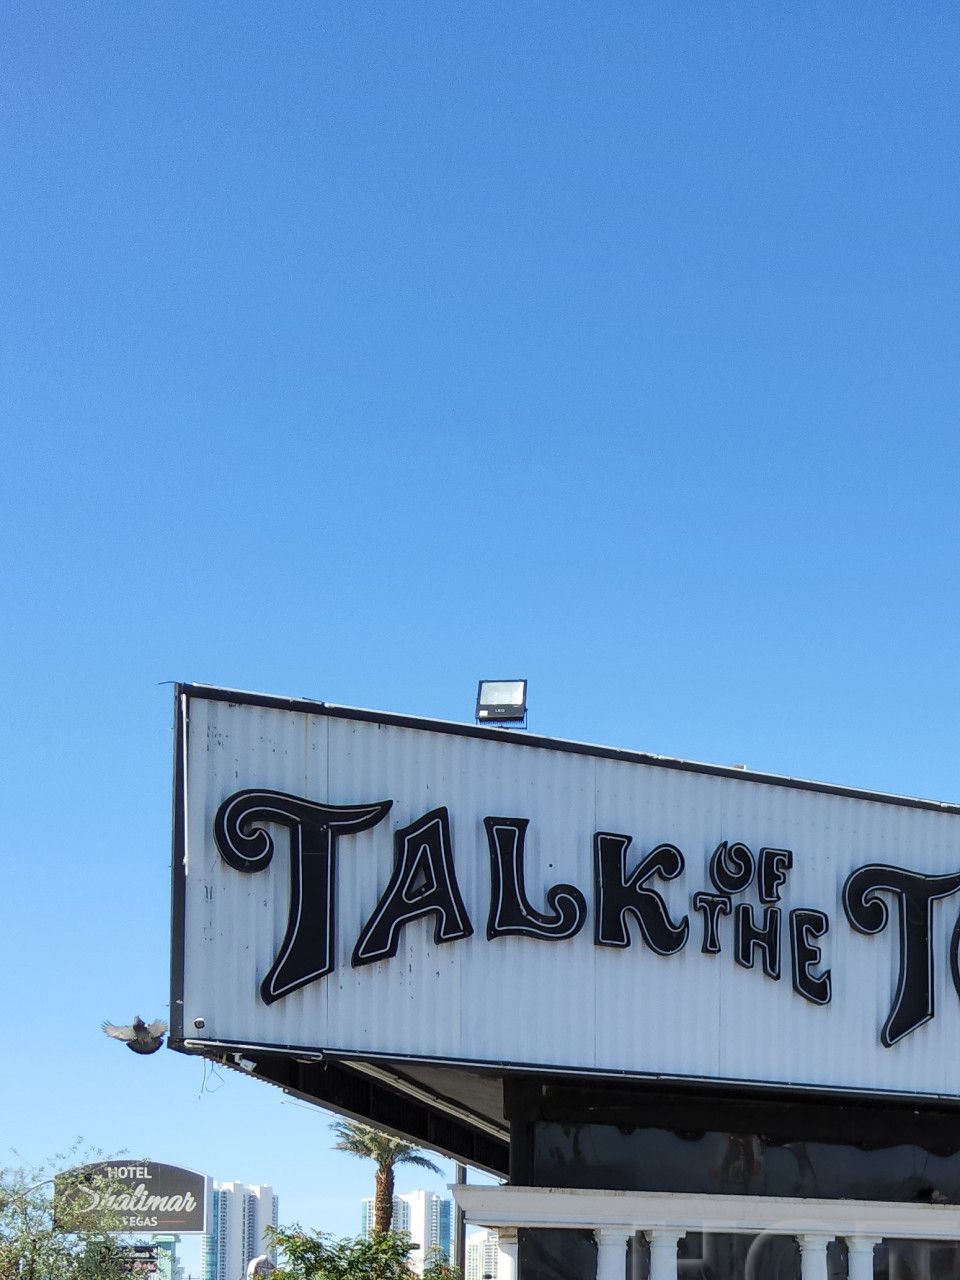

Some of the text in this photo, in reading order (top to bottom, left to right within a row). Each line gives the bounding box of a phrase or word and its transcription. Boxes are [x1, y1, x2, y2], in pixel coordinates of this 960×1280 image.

[214, 788, 689, 1006] TALK
[709, 840, 793, 905] OF
[693, 892, 832, 1006] THE
[107, 1166, 152, 1179] HOTEL
